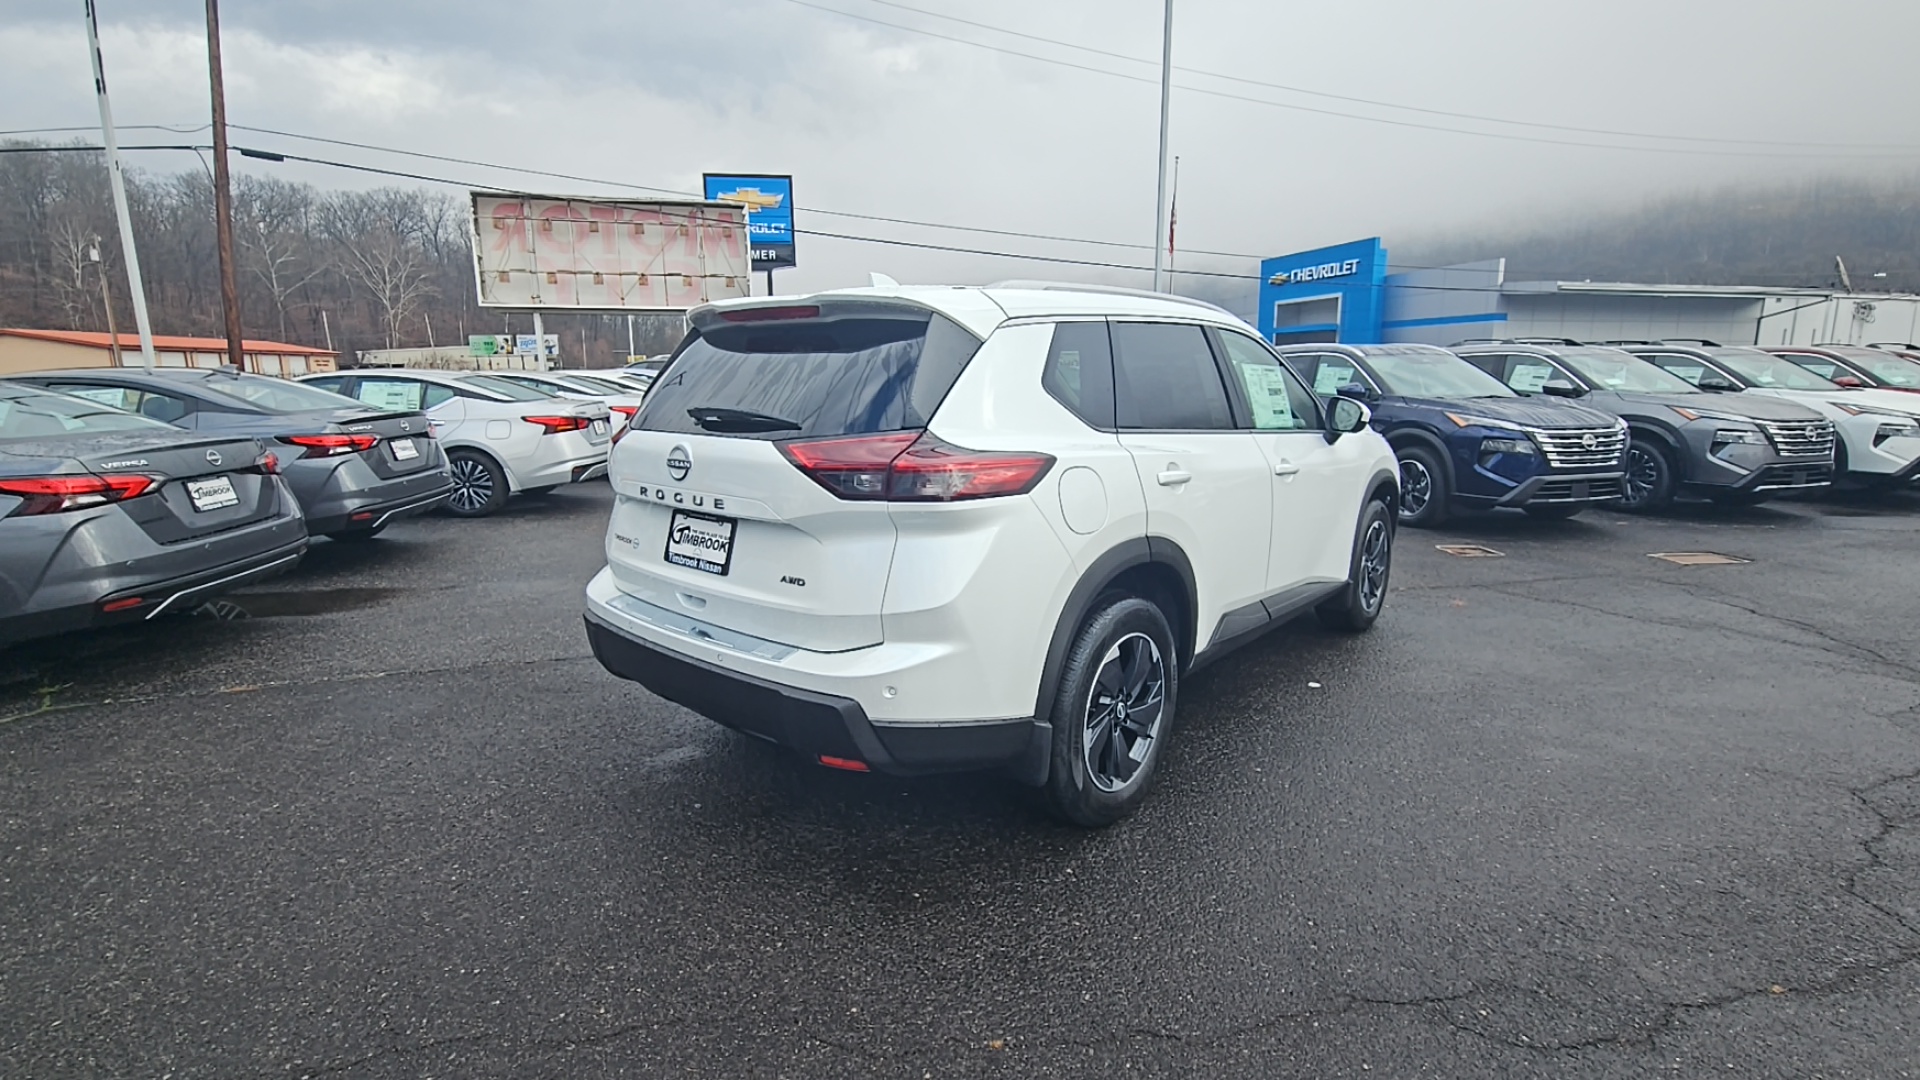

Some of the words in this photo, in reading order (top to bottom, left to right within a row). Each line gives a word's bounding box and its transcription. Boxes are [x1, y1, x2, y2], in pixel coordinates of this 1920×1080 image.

[750, 222, 787, 234] ROLET
[750, 249, 777, 260] MER
[1290, 258, 1361, 284] CHEVROLET
[100, 459, 150, 471] VERSA
[639, 485, 726, 510] ROGUE
[671, 522, 731, 554] TIMBROOK
[668, 552, 699, 568] Timbrook
[698, 558, 723, 575] Nissan
[780, 574, 806, 587] AWD
